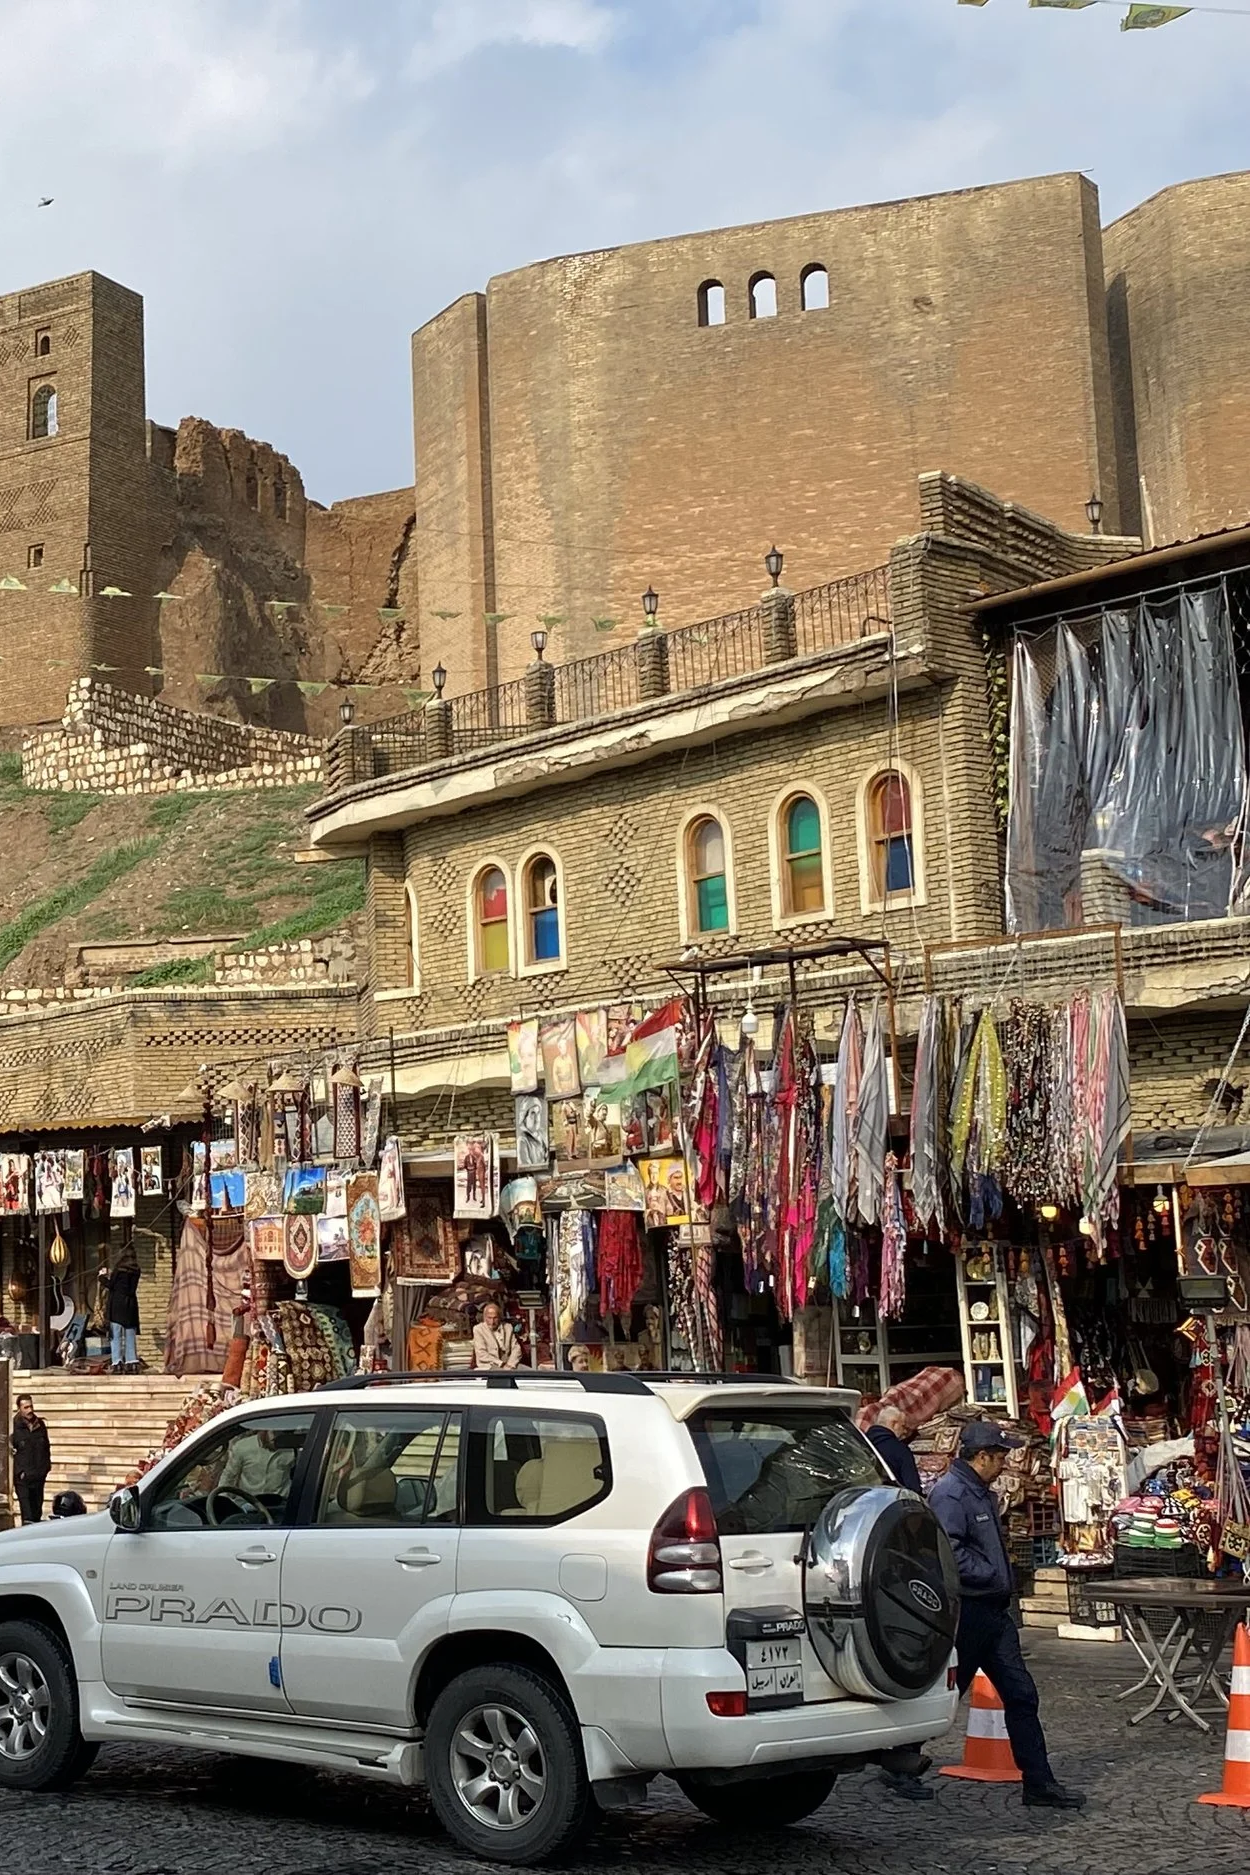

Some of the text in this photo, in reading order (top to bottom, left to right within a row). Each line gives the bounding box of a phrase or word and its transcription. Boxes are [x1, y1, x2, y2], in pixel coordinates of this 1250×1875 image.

[109, 1582, 137, 1591] LAND
[912, 1583, 938, 1608] PRADO
[105, 1594, 363, 1634] PRADO
[775, 1620, 804, 1632] PRADO
